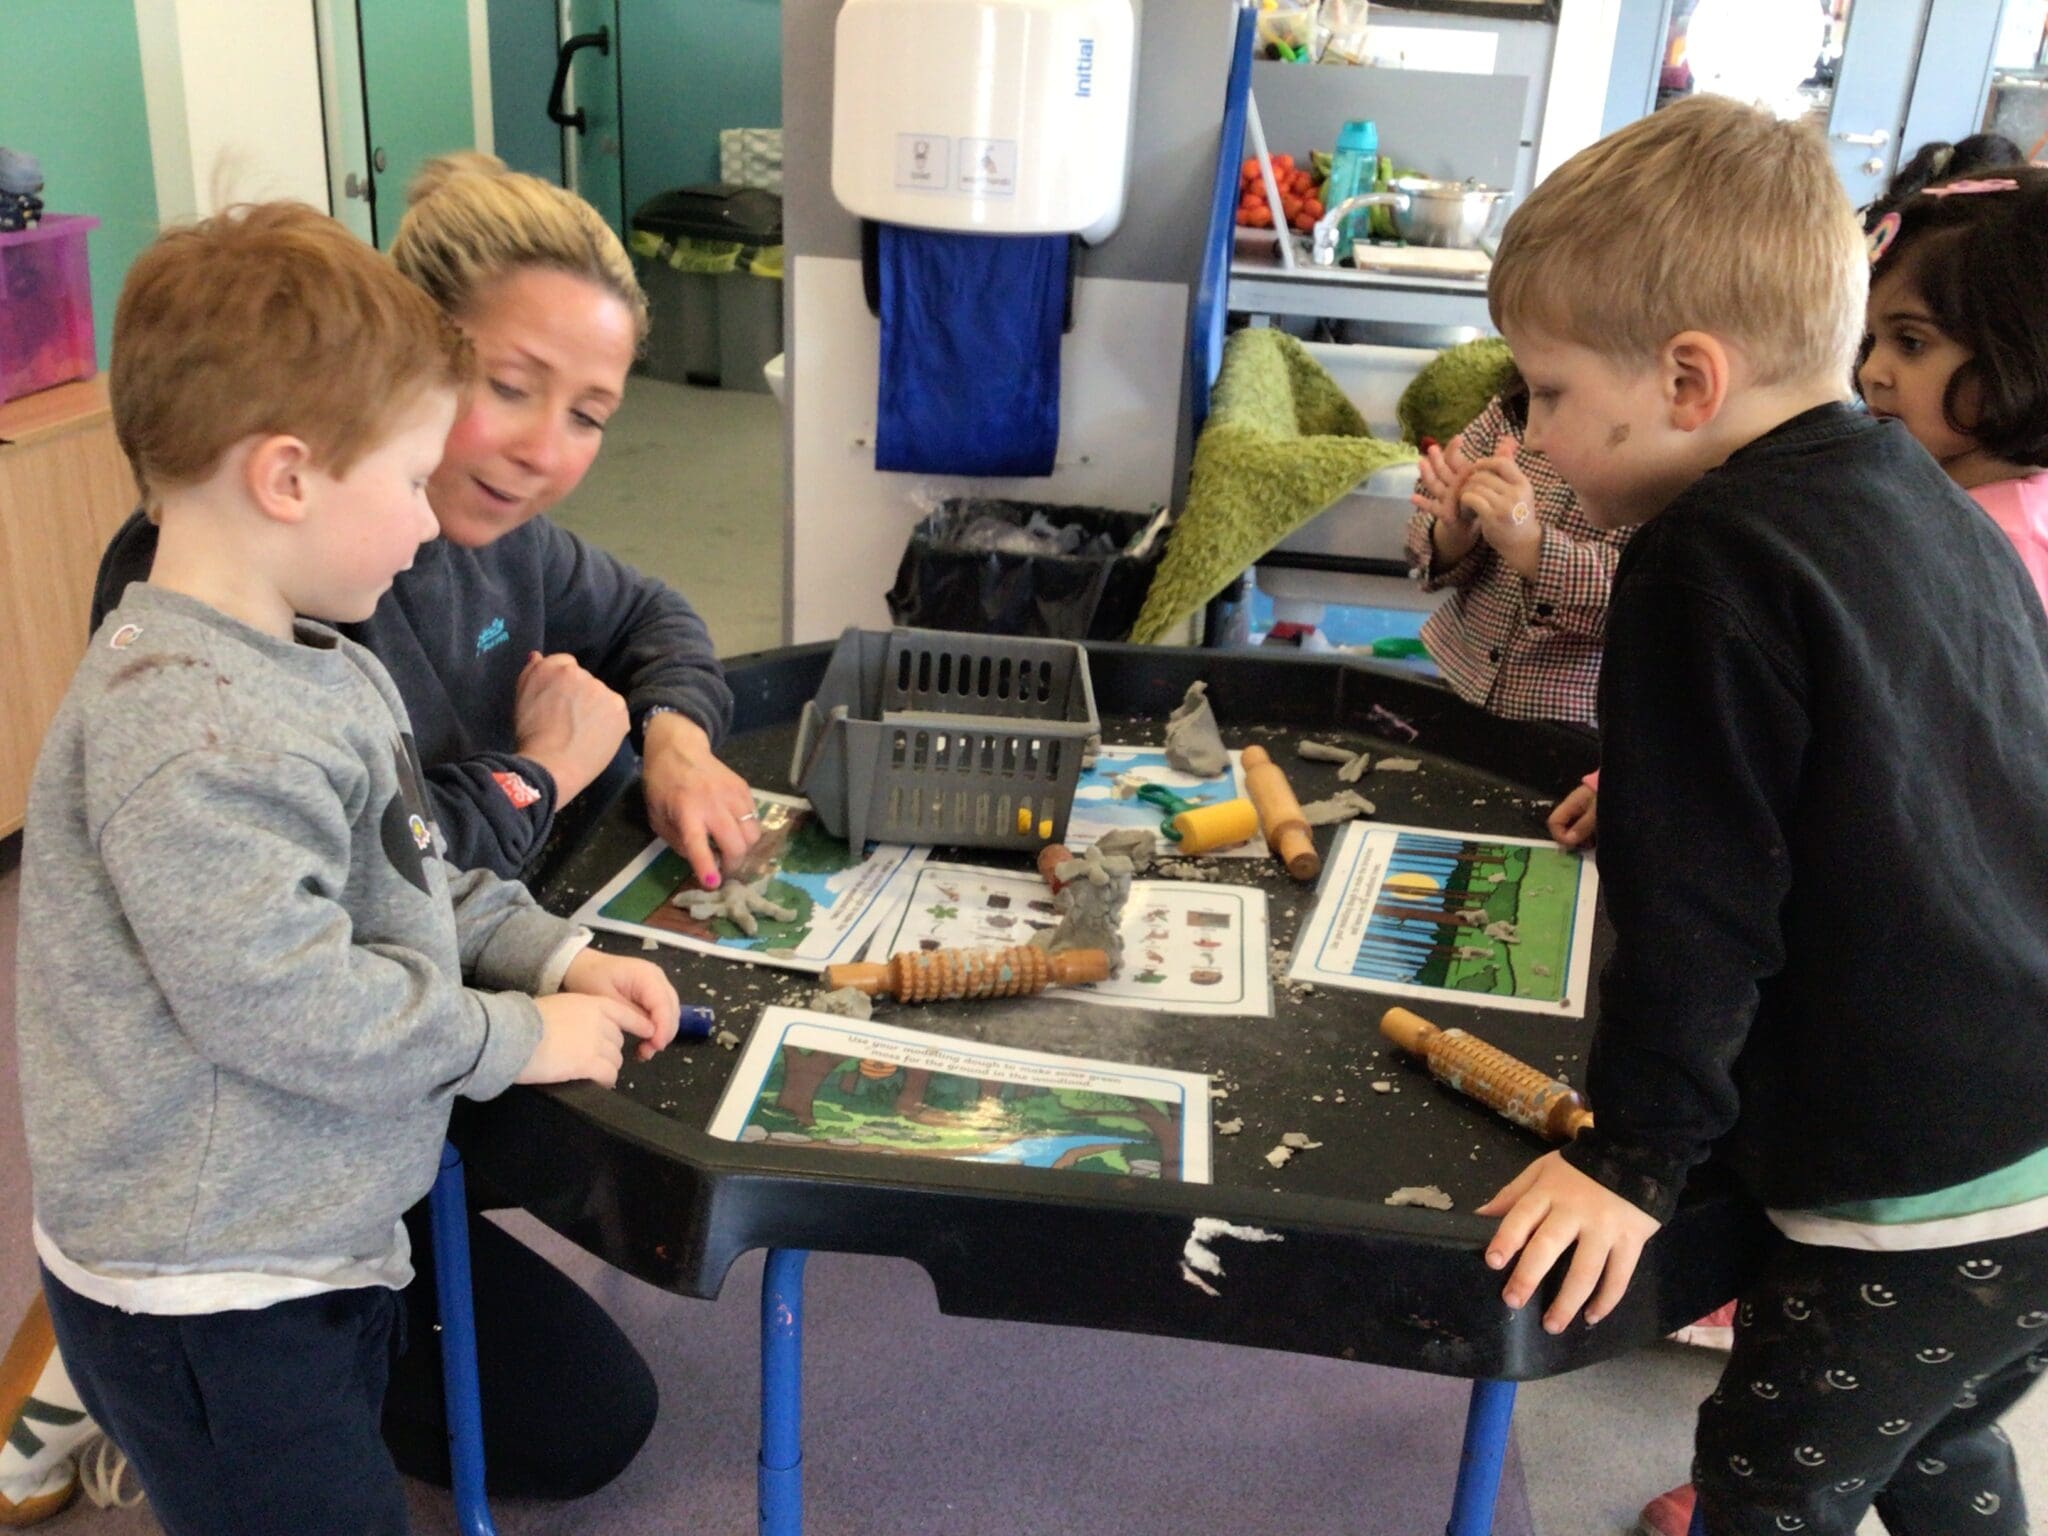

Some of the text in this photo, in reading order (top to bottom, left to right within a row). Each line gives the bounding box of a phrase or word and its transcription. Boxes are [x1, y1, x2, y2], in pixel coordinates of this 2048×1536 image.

[1075, 38, 1094, 97] Initial
[847, 1034, 869, 1044] Use
[872, 1040, 898, 1051] your
[903, 1055, 921, 1063] for
[925, 1058, 944, 1067] the
[947, 1063, 989, 1075] ground
[1009, 1072, 1028, 1080] the
